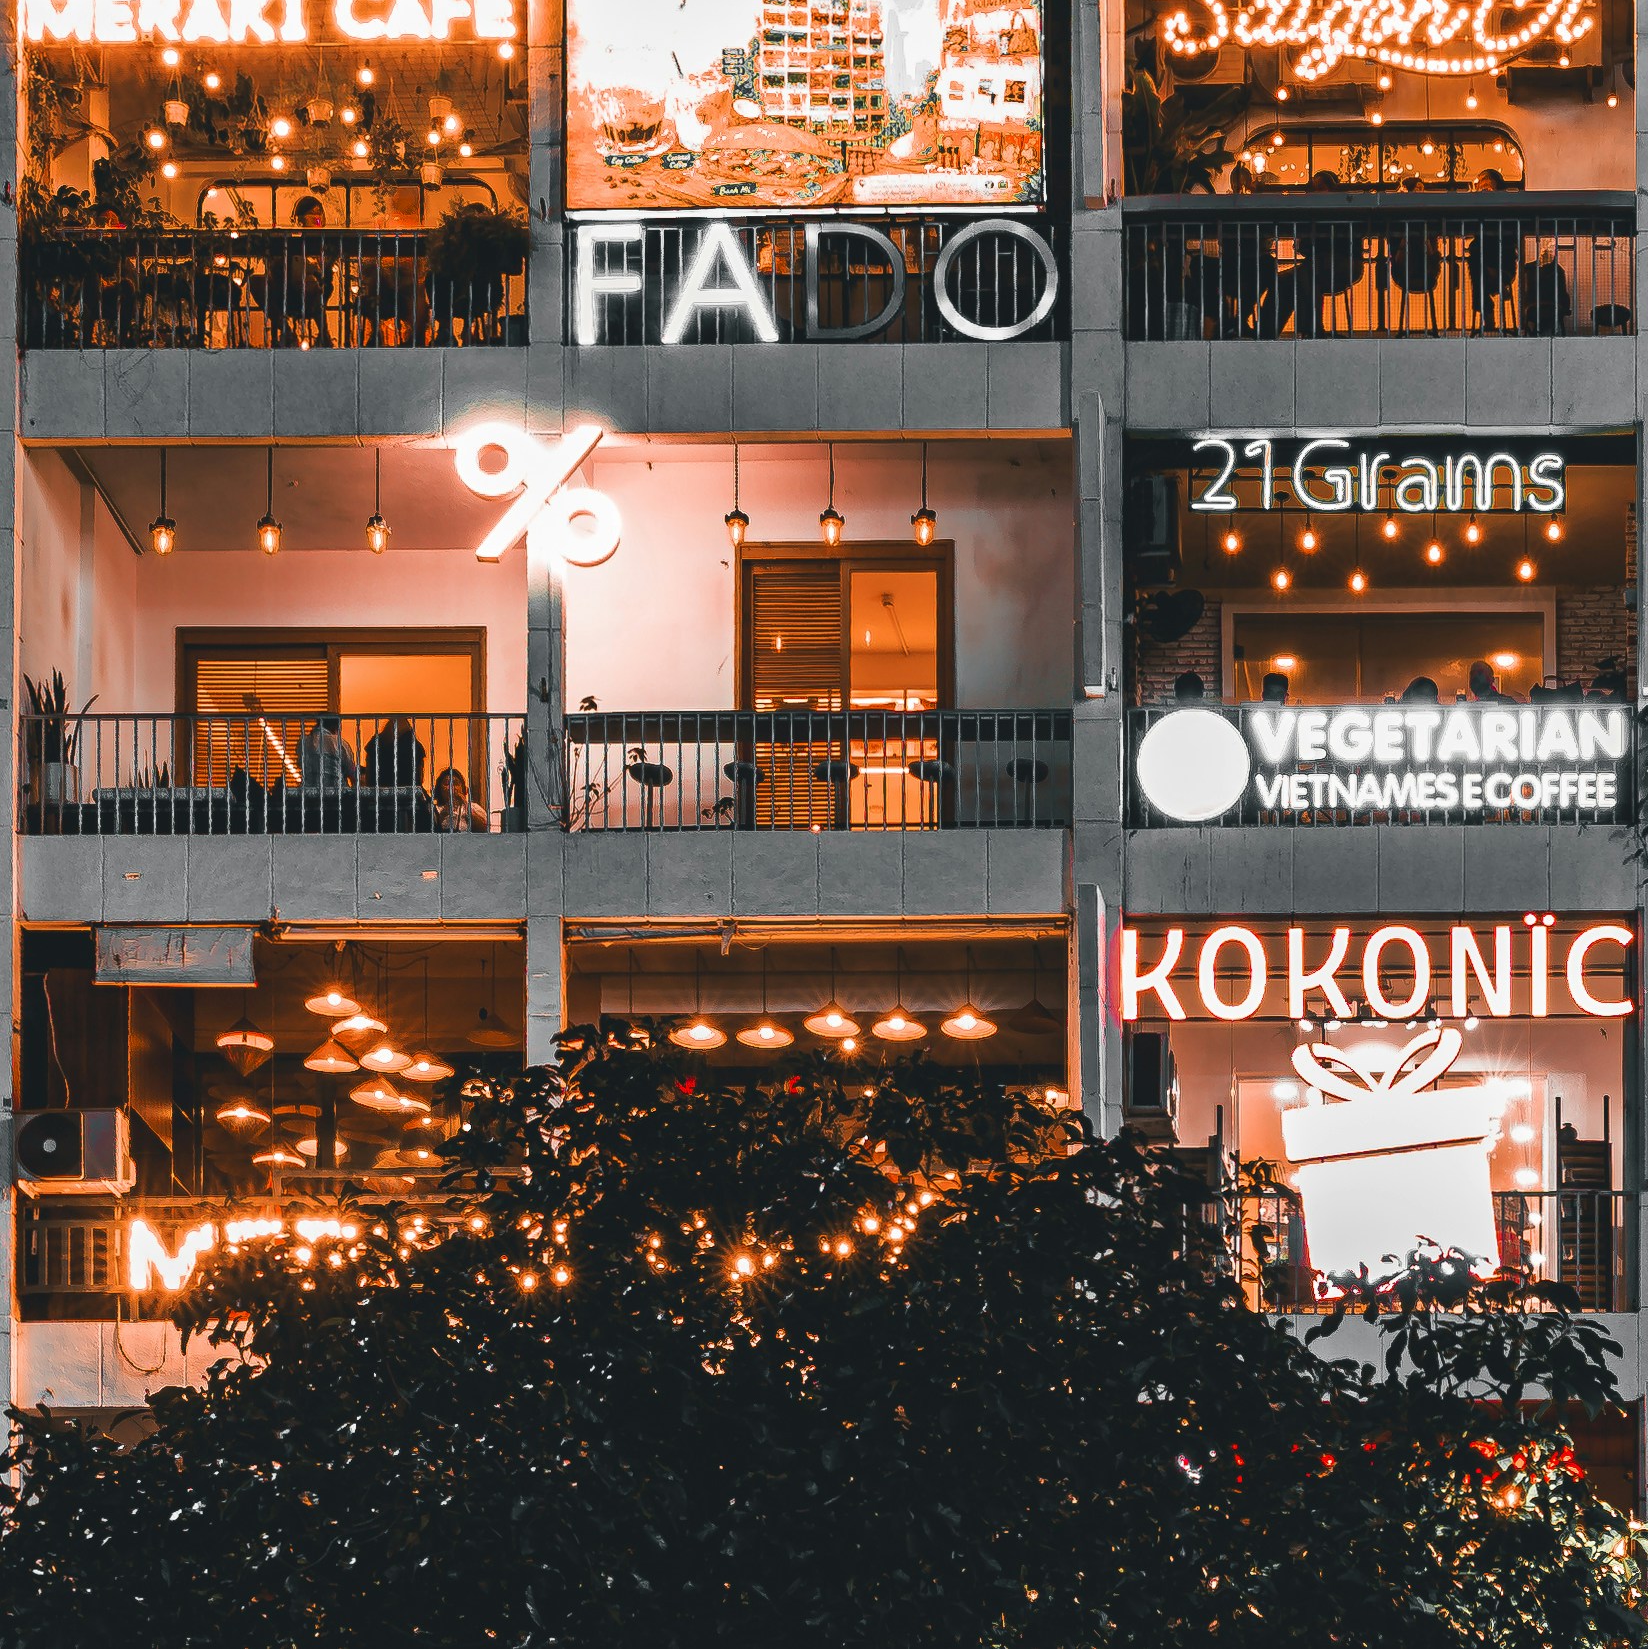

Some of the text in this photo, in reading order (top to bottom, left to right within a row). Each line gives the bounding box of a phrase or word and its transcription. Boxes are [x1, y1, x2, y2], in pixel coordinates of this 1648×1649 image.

[574, 220, 1060, 346] FADO
[1251, 710, 1629, 764] VEGETARIAN
[1121, 911, 1635, 1022] KOKONÏC
